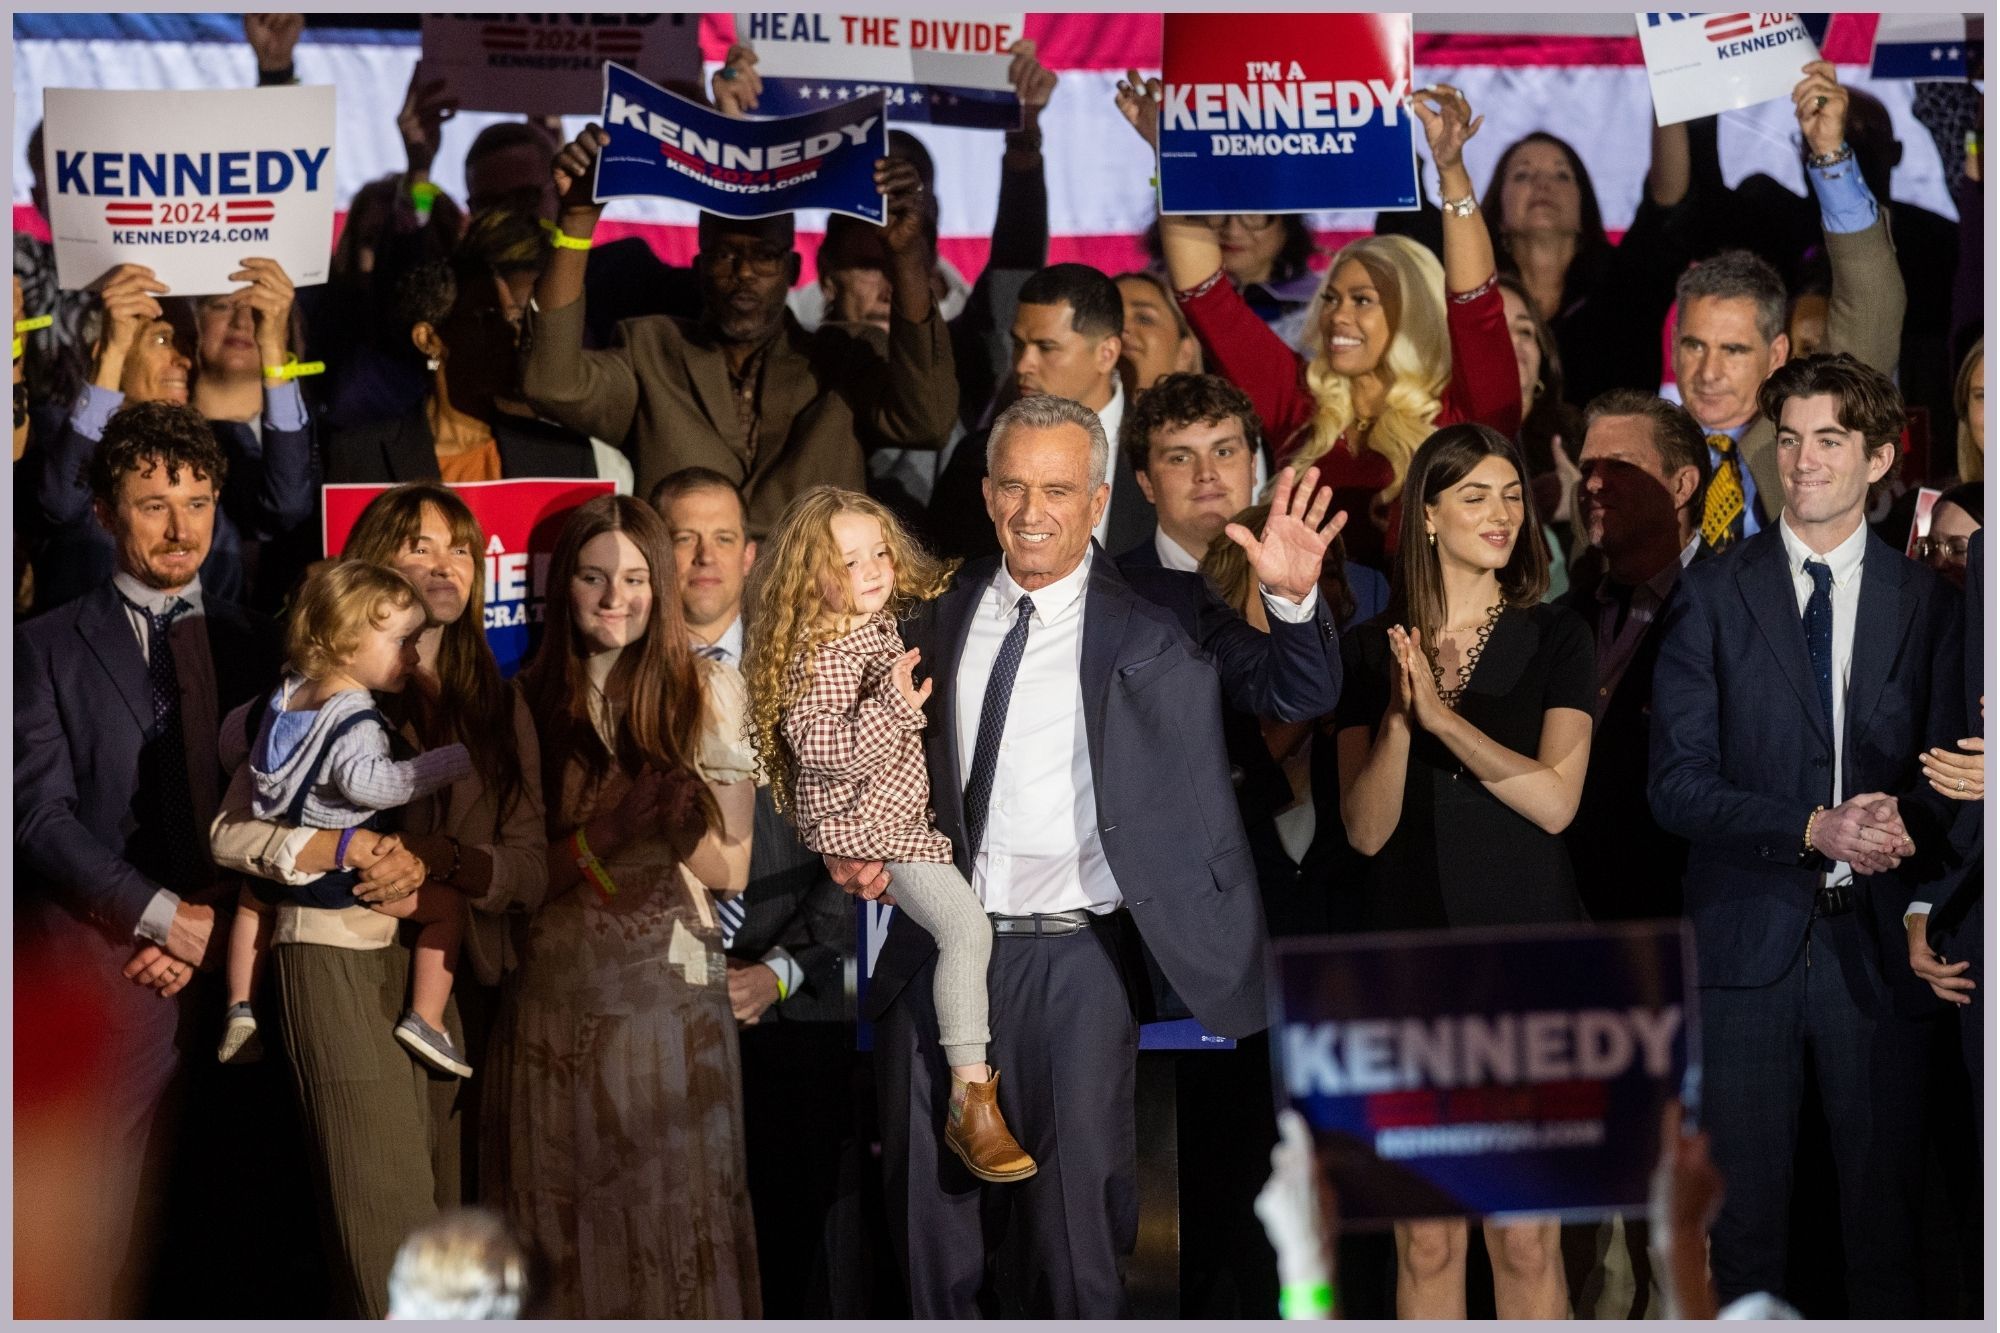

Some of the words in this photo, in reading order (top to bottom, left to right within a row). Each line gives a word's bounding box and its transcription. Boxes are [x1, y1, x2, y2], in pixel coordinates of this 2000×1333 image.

[534, 30, 592, 52] 2024
[750, 13, 830, 43] HEAL
[840, 16, 900, 47] THE
[910, 19, 1012, 55] DIVIDE
[1246, 61, 1282, 82] I'M
[1287, 61, 1306, 81] A
[1163, 79, 1410, 131] KENNEDY
[608, 93, 879, 171] KENNEDY
[1211, 132, 1357, 156] DEMOCRAT
[56, 147, 330, 197] KENNEDY
[666, 157, 818, 194] KENNEDY24.COM
[711, 166, 771, 183] 2024
[160, 202, 221, 224] 2024
[113, 228, 269, 245] KENNEDY24.COM
[483, 603, 547, 630] CRAT
[1284, 1005, 1682, 1097] KENNEDY
